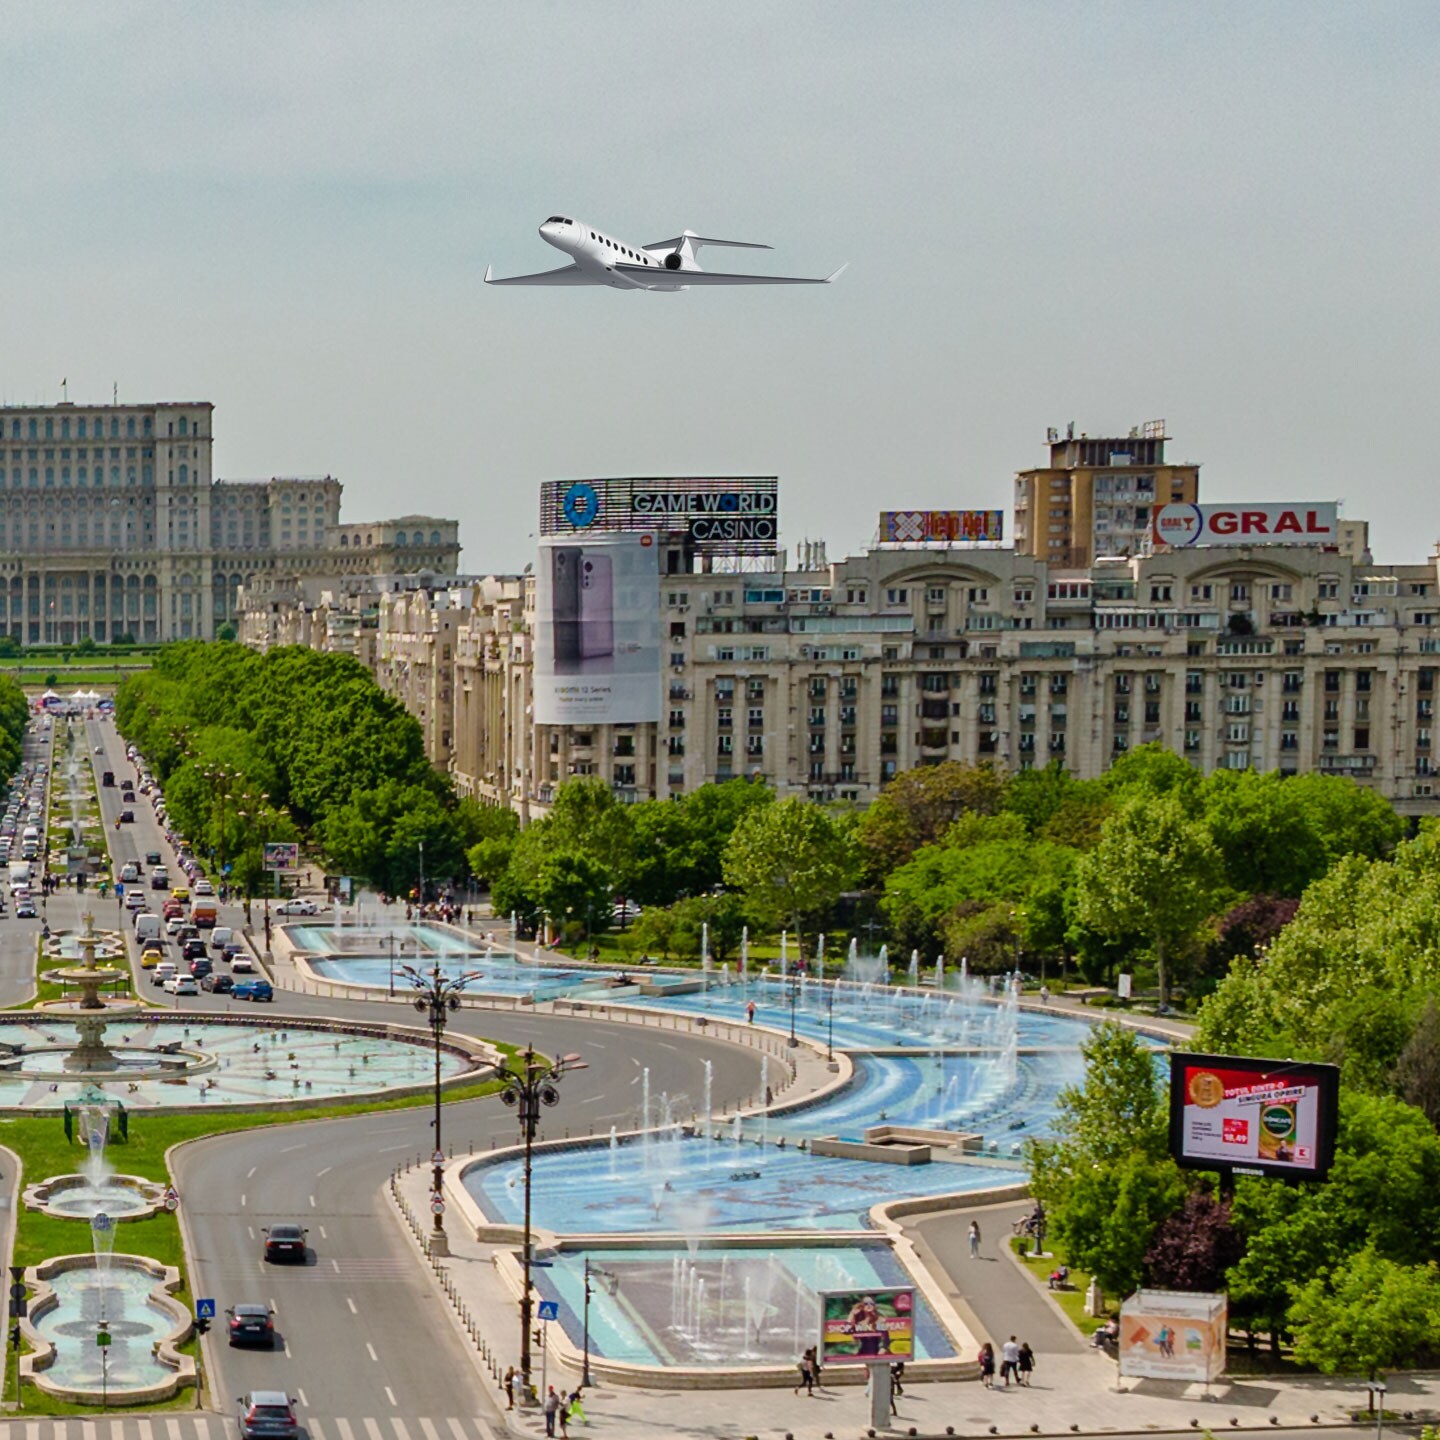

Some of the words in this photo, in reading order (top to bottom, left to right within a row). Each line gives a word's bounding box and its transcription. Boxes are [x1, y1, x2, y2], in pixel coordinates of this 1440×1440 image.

[633, 494, 698, 512] GAME
[702, 493, 775, 512] WORLD
[691, 520, 773, 539] CASINO
[1208, 510, 1331, 535] GRAL
